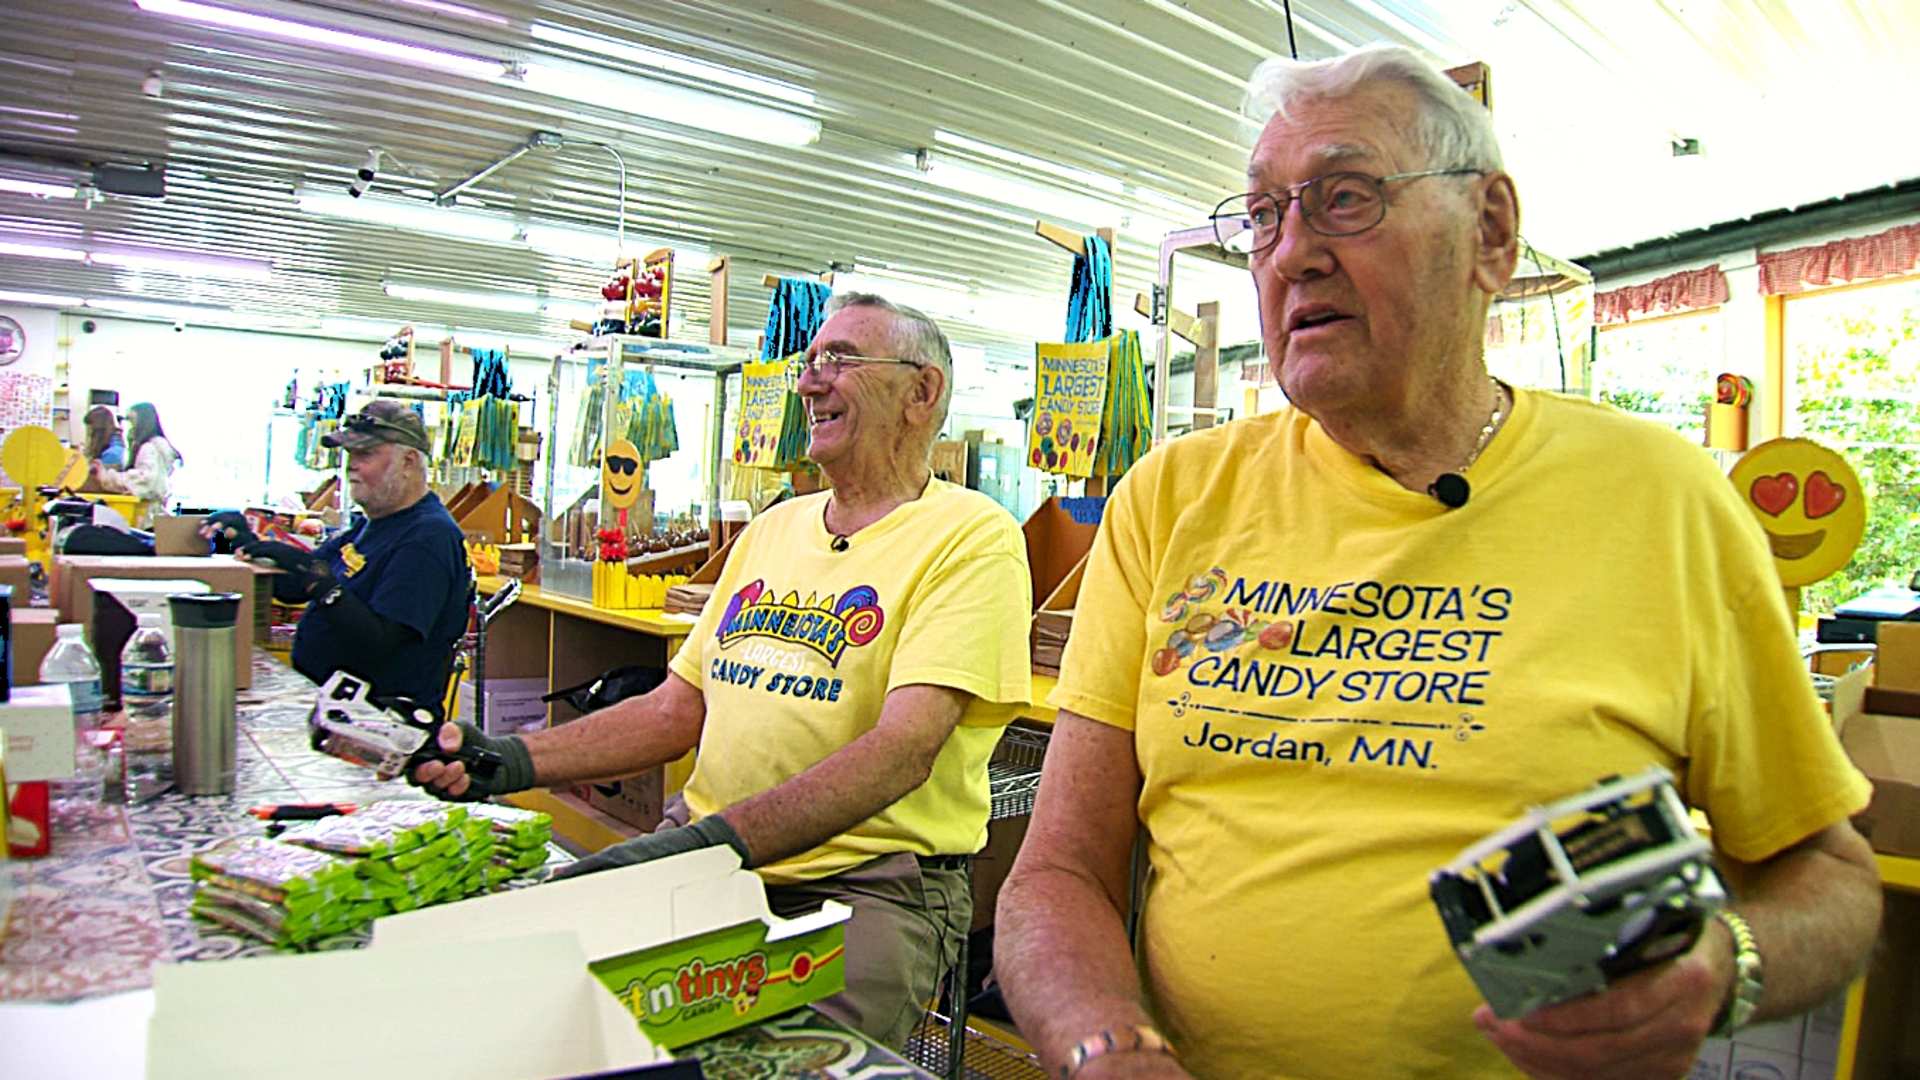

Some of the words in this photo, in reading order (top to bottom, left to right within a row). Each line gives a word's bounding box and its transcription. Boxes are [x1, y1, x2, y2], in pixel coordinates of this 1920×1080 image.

[1040, 396, 1074, 414] CANDY
[1041, 374, 1104, 398] LARGEST
[1223, 577, 1513, 622] MINNESOTA'S
[1289, 619, 1503, 662] LARGEST
[711, 657, 765, 689] CANDY
[766, 672, 843, 702] STORE
[1188, 655, 1337, 700] CANDY
[1337, 670, 1491, 706] STORE
[1183, 721, 1332, 767] Jordan,
[1348, 735, 1438, 770] MN.
[676, 954, 768, 1005] tinys
[681, 1002, 722, 1022] CANDY
